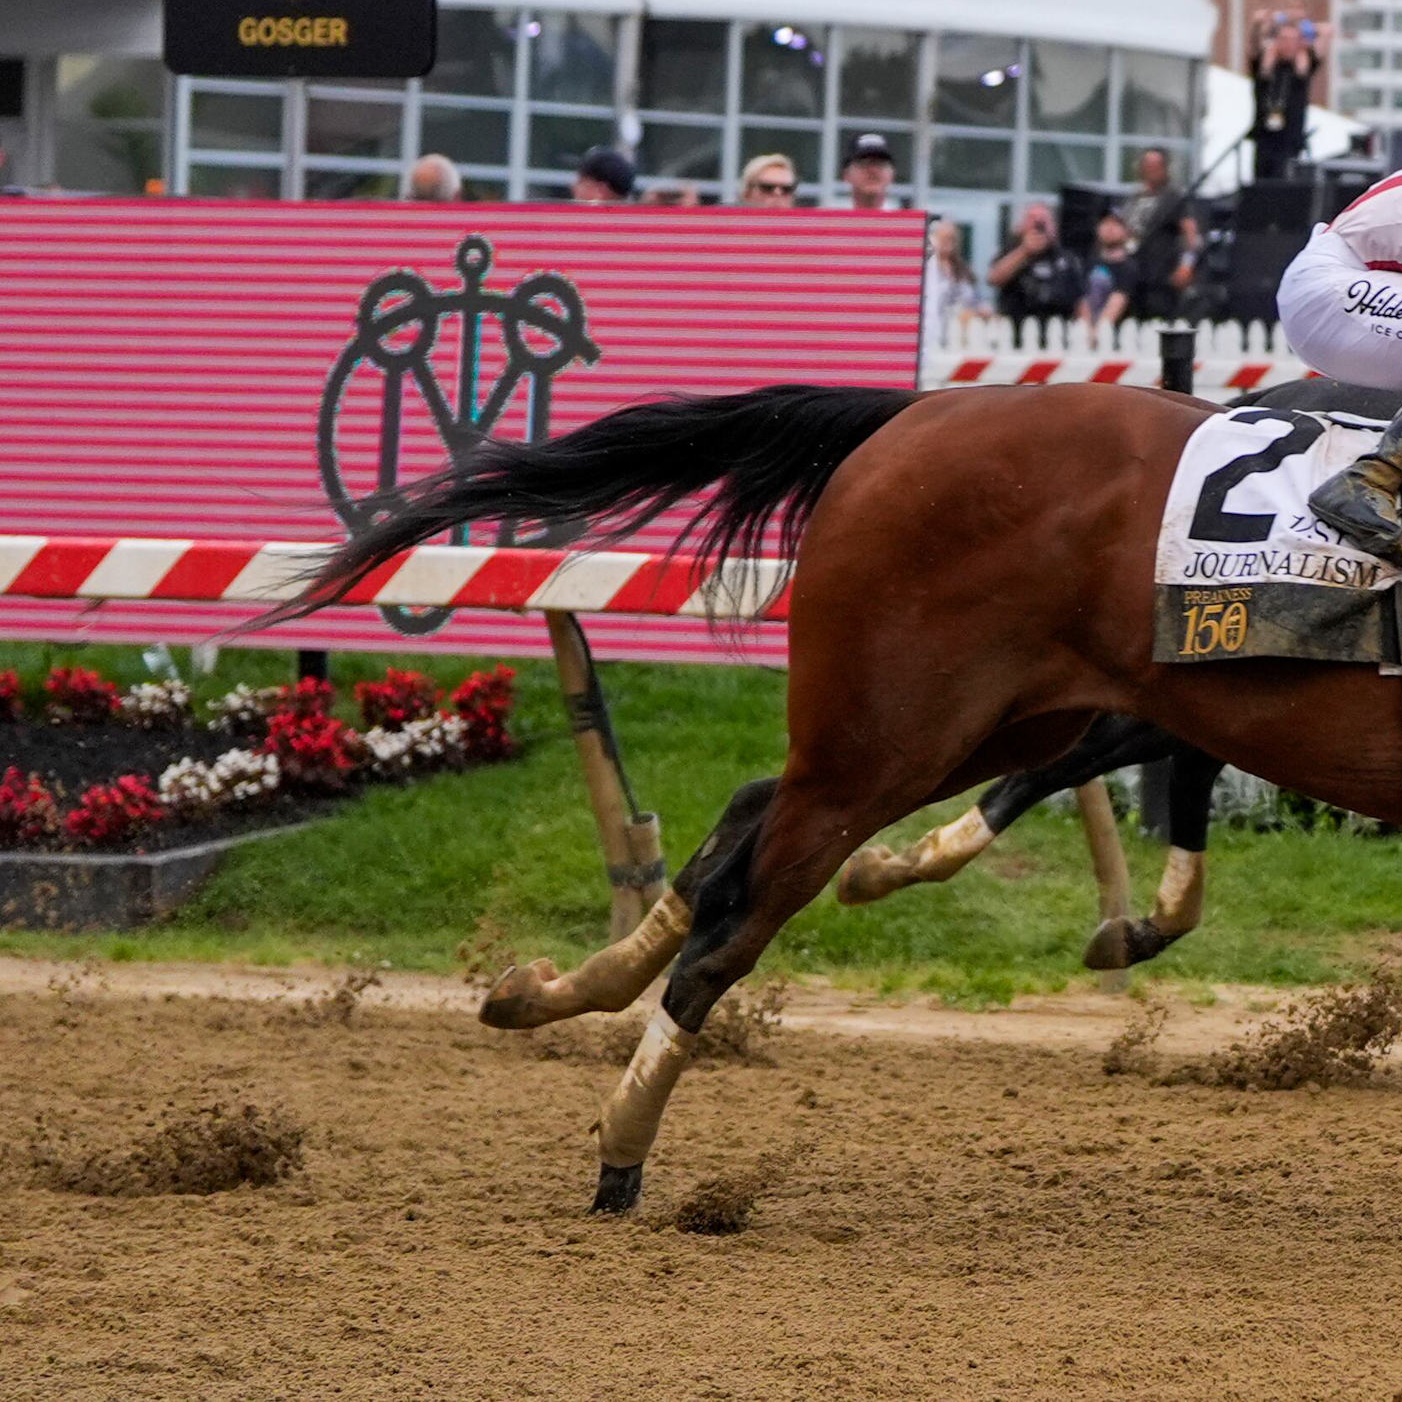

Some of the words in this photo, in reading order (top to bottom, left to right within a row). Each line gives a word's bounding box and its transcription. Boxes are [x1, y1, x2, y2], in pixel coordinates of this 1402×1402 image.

[238, 16, 349, 47] GOSGER
[1370, 323, 1392, 337] ICE
[1187, 409, 1327, 544] 2
[1184, 550, 1383, 588] JOURNALISM
[1178, 601, 1249, 656] 150
